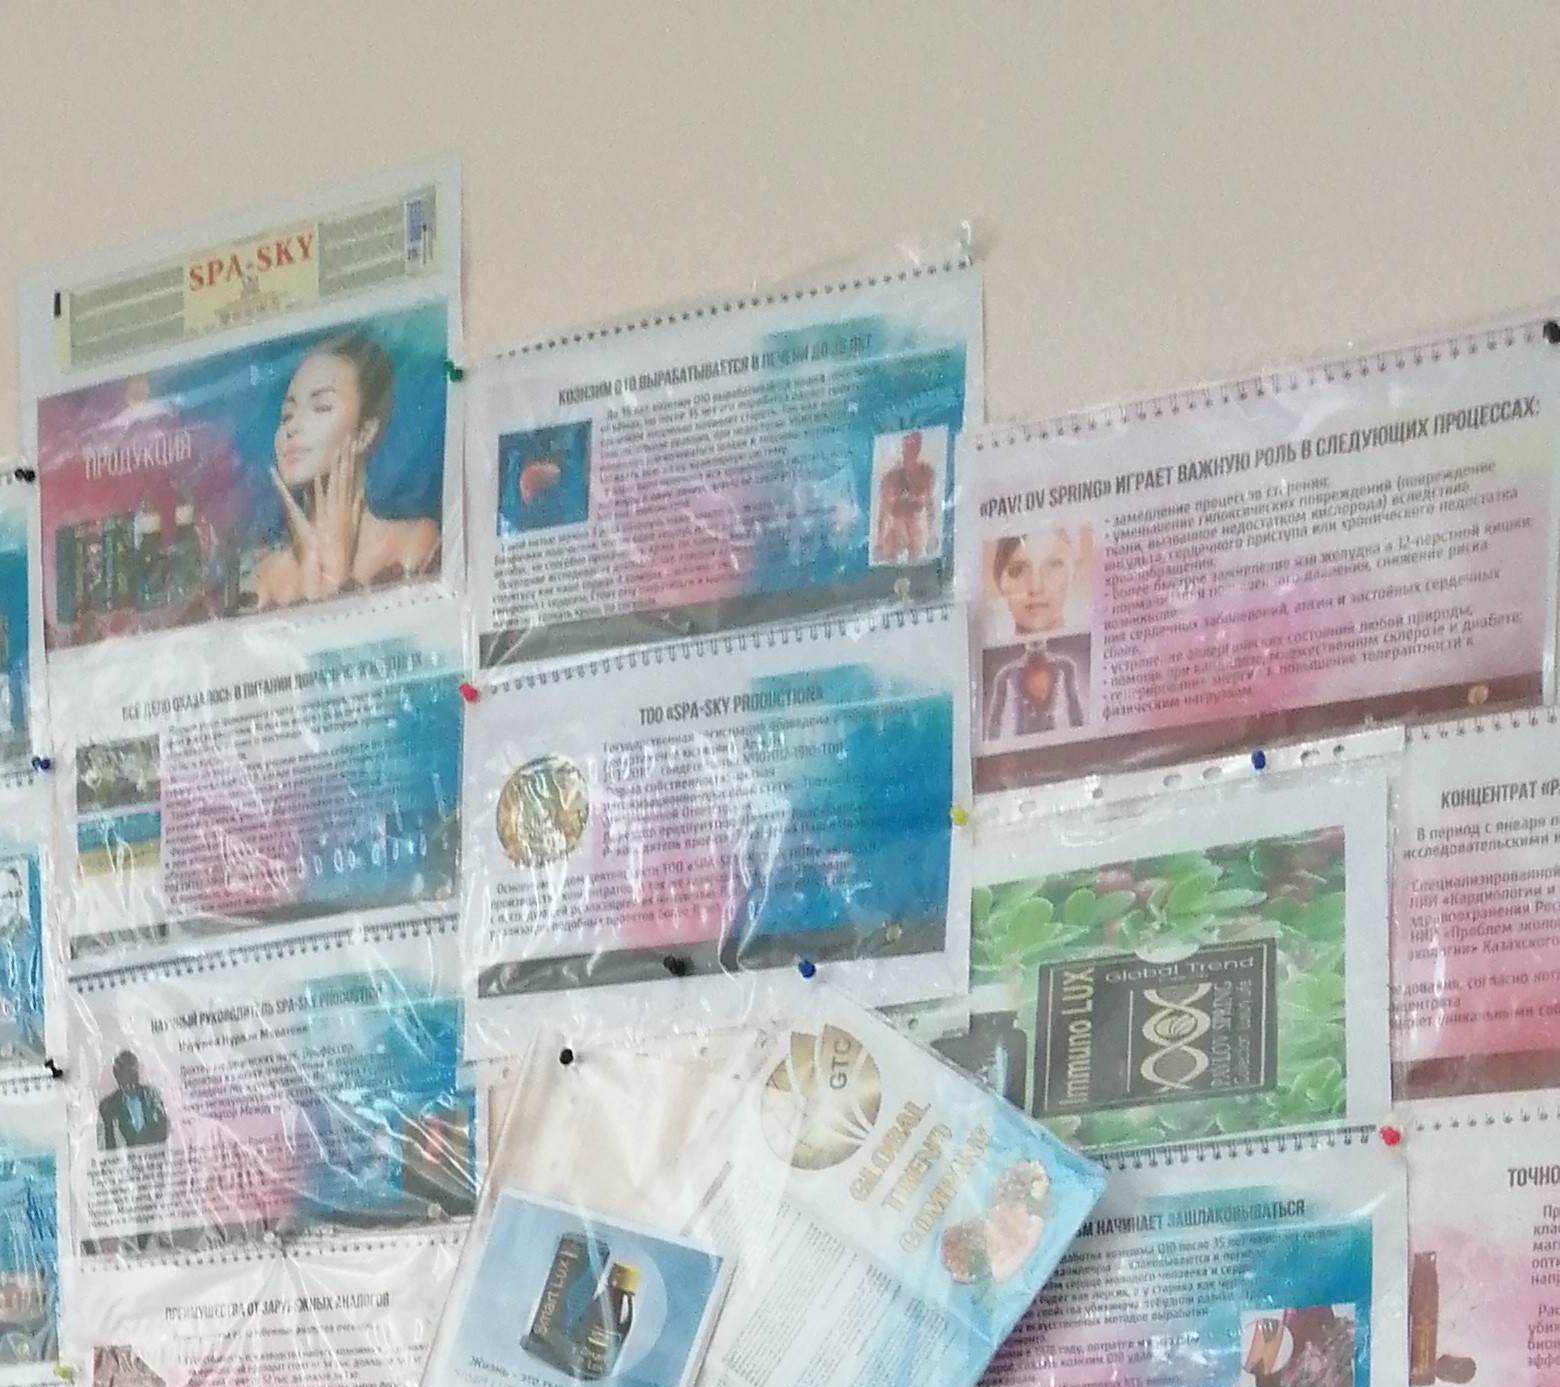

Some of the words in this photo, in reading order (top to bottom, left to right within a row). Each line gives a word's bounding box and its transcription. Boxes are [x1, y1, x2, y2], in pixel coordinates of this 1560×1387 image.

[189, 232, 315, 292] SPA-SKY
[84, 434, 192, 479] ПРОДУКЦИЯ
[1049, 475, 1111, 507] SPRING»
[1115, 465, 1171, 495] ИГРАЕТ
[1178, 450, 1249, 484] ВАЖНУЮ
[1255, 441, 1296, 467] РОЛЬ
[1301, 439, 1311, 460] В
[1316, 417, 1429, 459] СЛЕДУЮЩИХ
[1433, 395, 1539, 437] ПРОЦЕССАХ:
[666, 696, 728, 723] «SPA-SKY
[1440, 780, 1537, 810] КОНЦЕНТРАТ
[1429, 823, 1479, 843] период
[1062, 966, 1095, 1016] LUX
[1106, 964, 1179, 984] Global
[1189, 956, 1254, 978] Trend
[829, 1040, 852, 1090] GTC
[1058, 1020, 1092, 1107] Immuno
[850, 1101, 931, 1202] GLOBAL
[880, 1123, 953, 1213] TREND
[1096, 1212, 1162, 1237] НАЧИНАЕТ
[1167, 1198, 1304, 1228] ЗАШЛАКОВЫВАТЬСЯ
